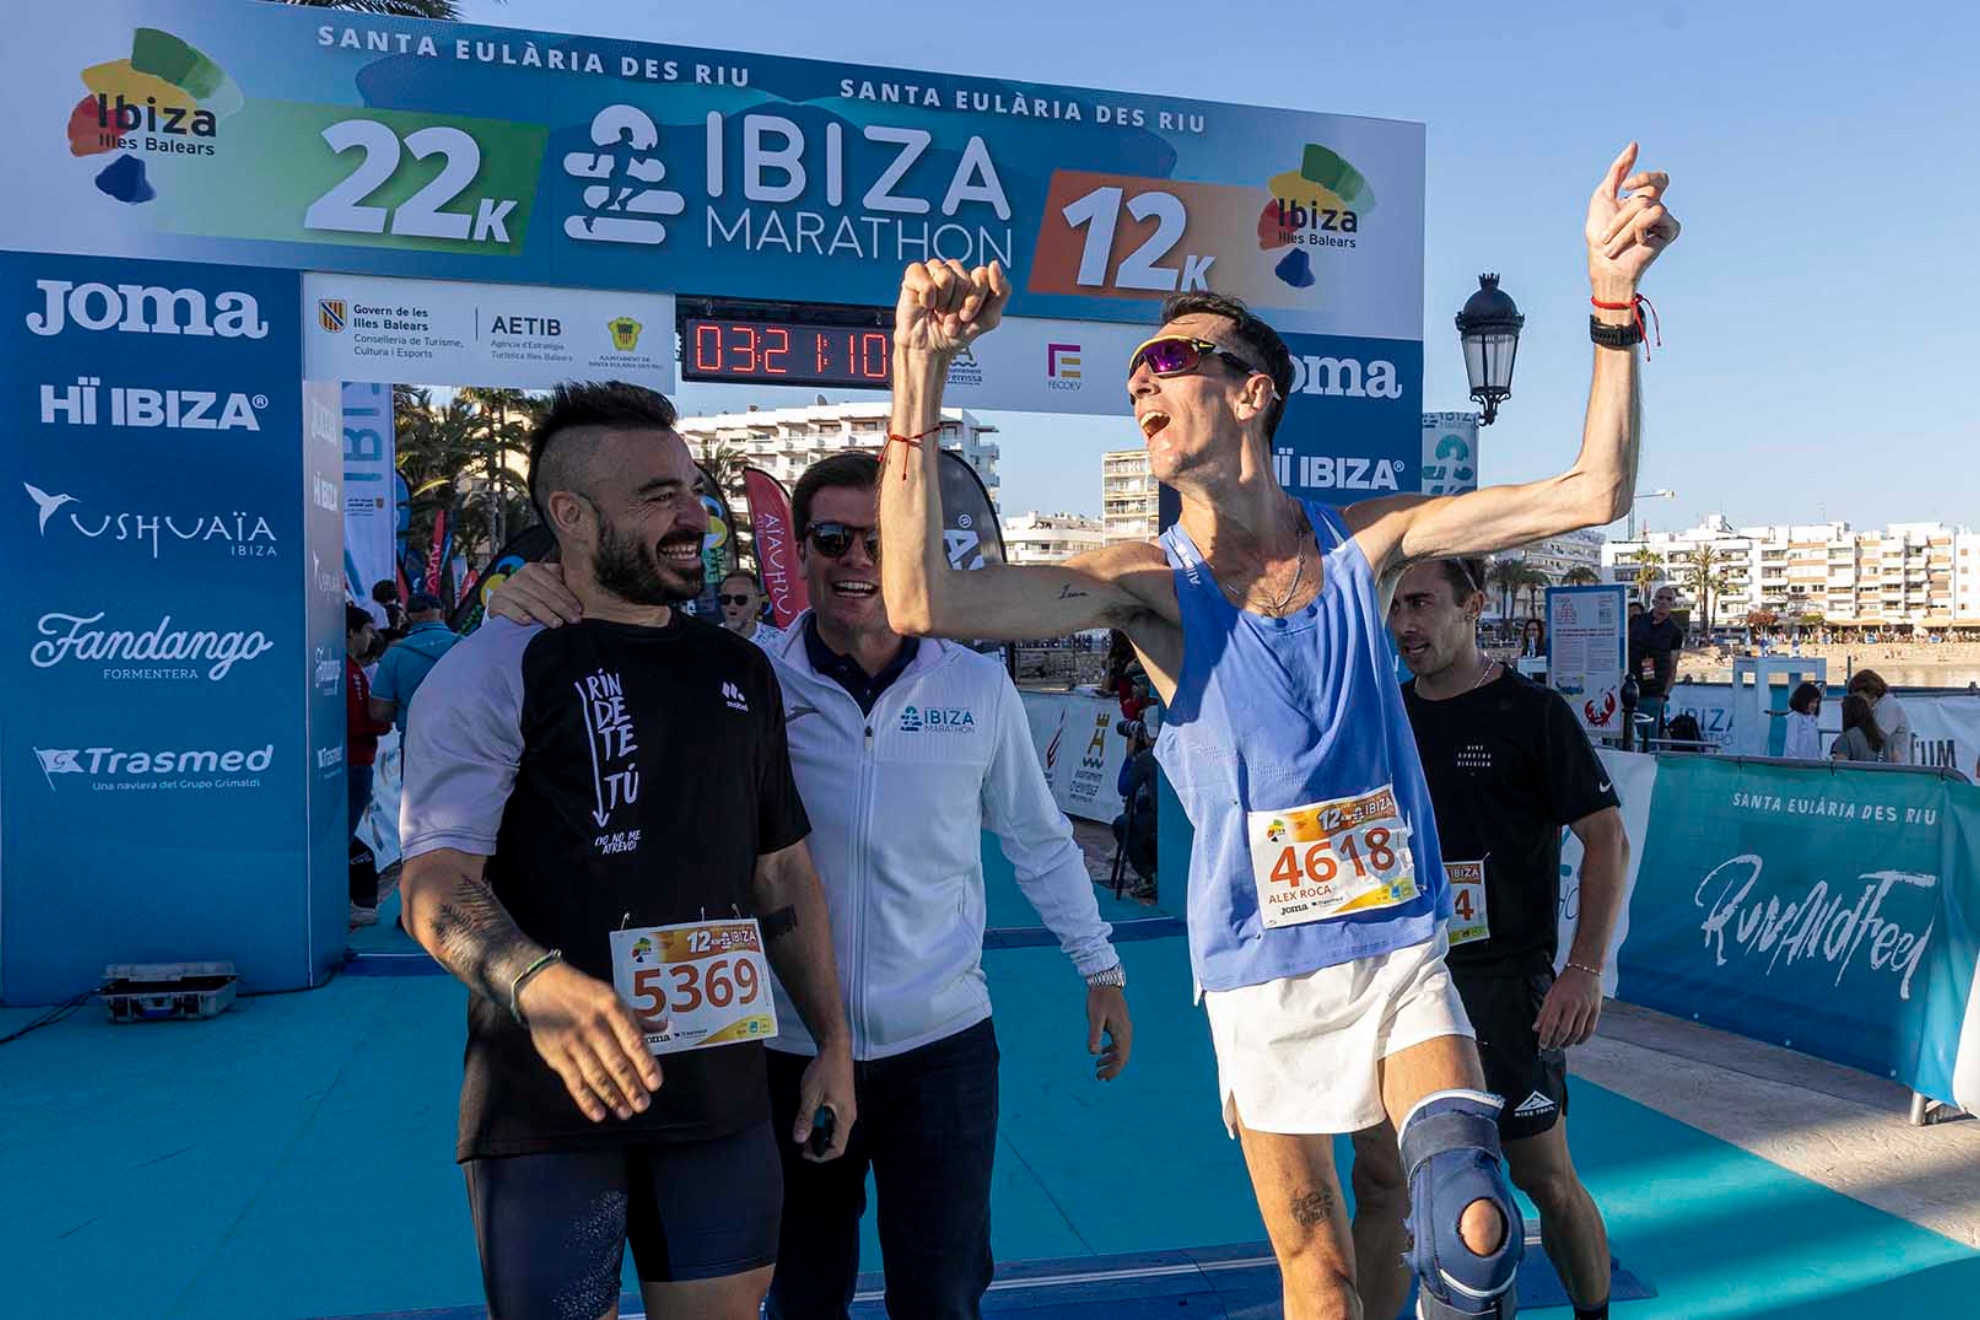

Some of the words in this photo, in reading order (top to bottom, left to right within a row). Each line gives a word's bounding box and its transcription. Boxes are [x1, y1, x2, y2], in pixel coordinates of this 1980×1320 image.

[317, 25, 438, 57] SANTA
[456, 39, 604, 74] EULÀRIA
[621, 56, 679, 81] DES
[696, 64, 750, 88] RIU
[98, 93, 217, 137] Ibiza
[840, 78, 941, 108] SANTA
[956, 90, 1081, 121] EULÀRIA
[1096, 105, 1145, 127] DES
[1159, 111, 1205, 133] RIU
[98, 133, 138, 152] Illes
[145, 135, 215, 156] Balears
[706, 110, 1011, 220] IBIZA
[1278, 197, 1358, 233] Ibiza
[706, 205, 1012, 269] MARATHON
[1278, 231, 1304, 246] Illes
[1308, 233, 1356, 249] Balears
[353, 304, 393, 316] Govern
[396, 307, 409, 317] de
[412, 308, 428, 318] les
[353, 318, 379, 329] Illes
[383, 319, 429, 331] Balears
[491, 315, 562, 336] AETIB
[354, 334, 407, 345] Conselleria
[410, 337, 421, 346] de
[354, 346, 388, 356] Cultura
[397, 349, 432, 359] Esports
[70, 511, 277, 558] USHUAÏA
[231, 545, 277, 557] IBIZA
[30, 611, 274, 681] Fandango
[103, 668, 199, 680] FORMENTERA
[924, 709, 974, 726] IBIZA
[85, 744, 274, 775] Trasmed
[92, 782, 114, 791] Una
[117, 781, 157, 791] naviera
[160, 781, 177, 790] del
[180, 780, 212, 791] Grupo
[215, 779, 260, 789] Grimaldi
[1365, 797, 1393, 815] IBIZA
[1732, 792, 1781, 812] SANTA
[1788, 797, 1855, 819] EULÀRIA
[1862, 805, 1897, 821] DES
[1906, 808, 1936, 825] RIU
[1270, 827, 1395, 888] 4618
[1269, 890, 1297, 904] ALEX
[1300, 885, 1332, 899] ROCA
[731, 930, 757, 944] IBIZA
[633, 958, 758, 1017] 5369
[647, 1034, 670, 1043] oma
